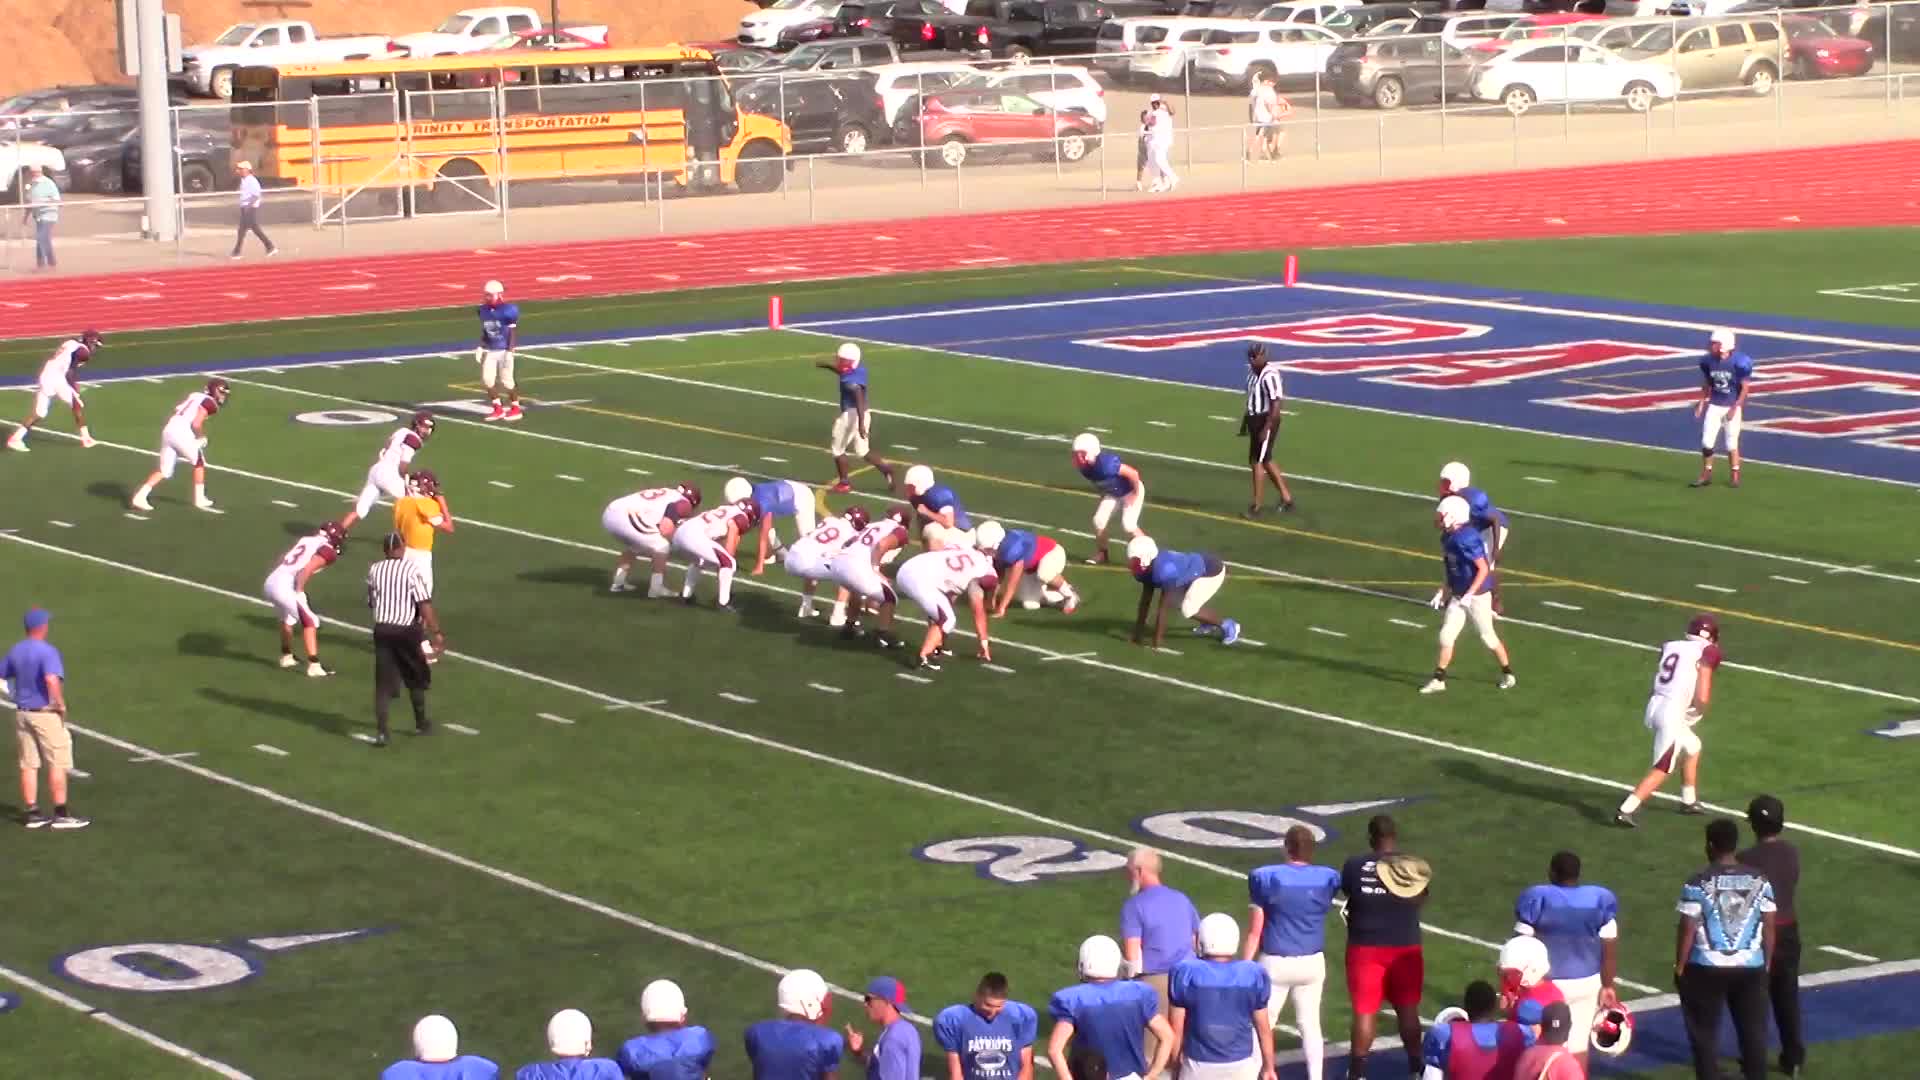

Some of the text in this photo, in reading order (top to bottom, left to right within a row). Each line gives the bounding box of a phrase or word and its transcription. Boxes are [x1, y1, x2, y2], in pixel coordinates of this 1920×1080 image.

[407, 122, 465, 134] RINITY
[1659, 653, 1680, 684] 9
[968, 1038, 1013, 1052] PATRIOTS
